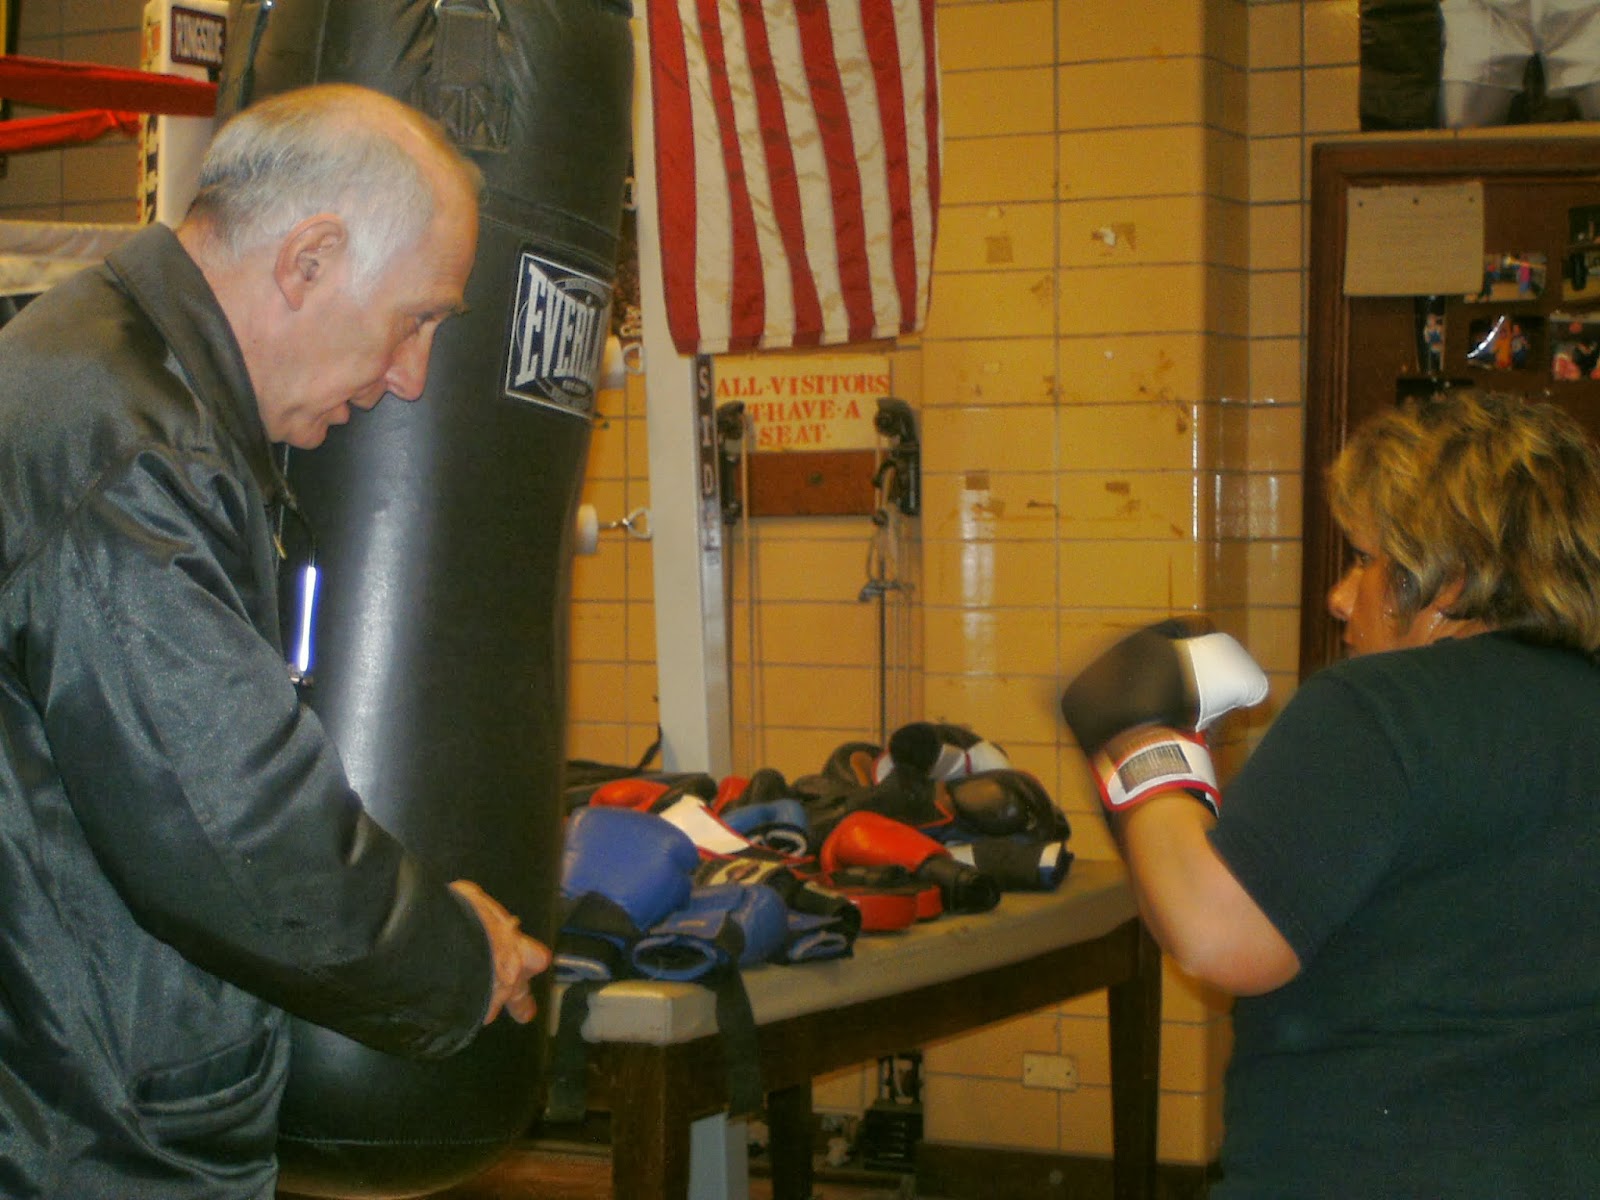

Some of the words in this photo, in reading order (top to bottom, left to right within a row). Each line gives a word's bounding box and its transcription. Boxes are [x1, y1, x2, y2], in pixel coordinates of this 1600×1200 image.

[175, 13, 223, 63] RINGSIDE
[515, 263, 603, 387] EVERL
[716, 376, 763, 397] ALL
[770, 373, 889, 396] VISITORS
